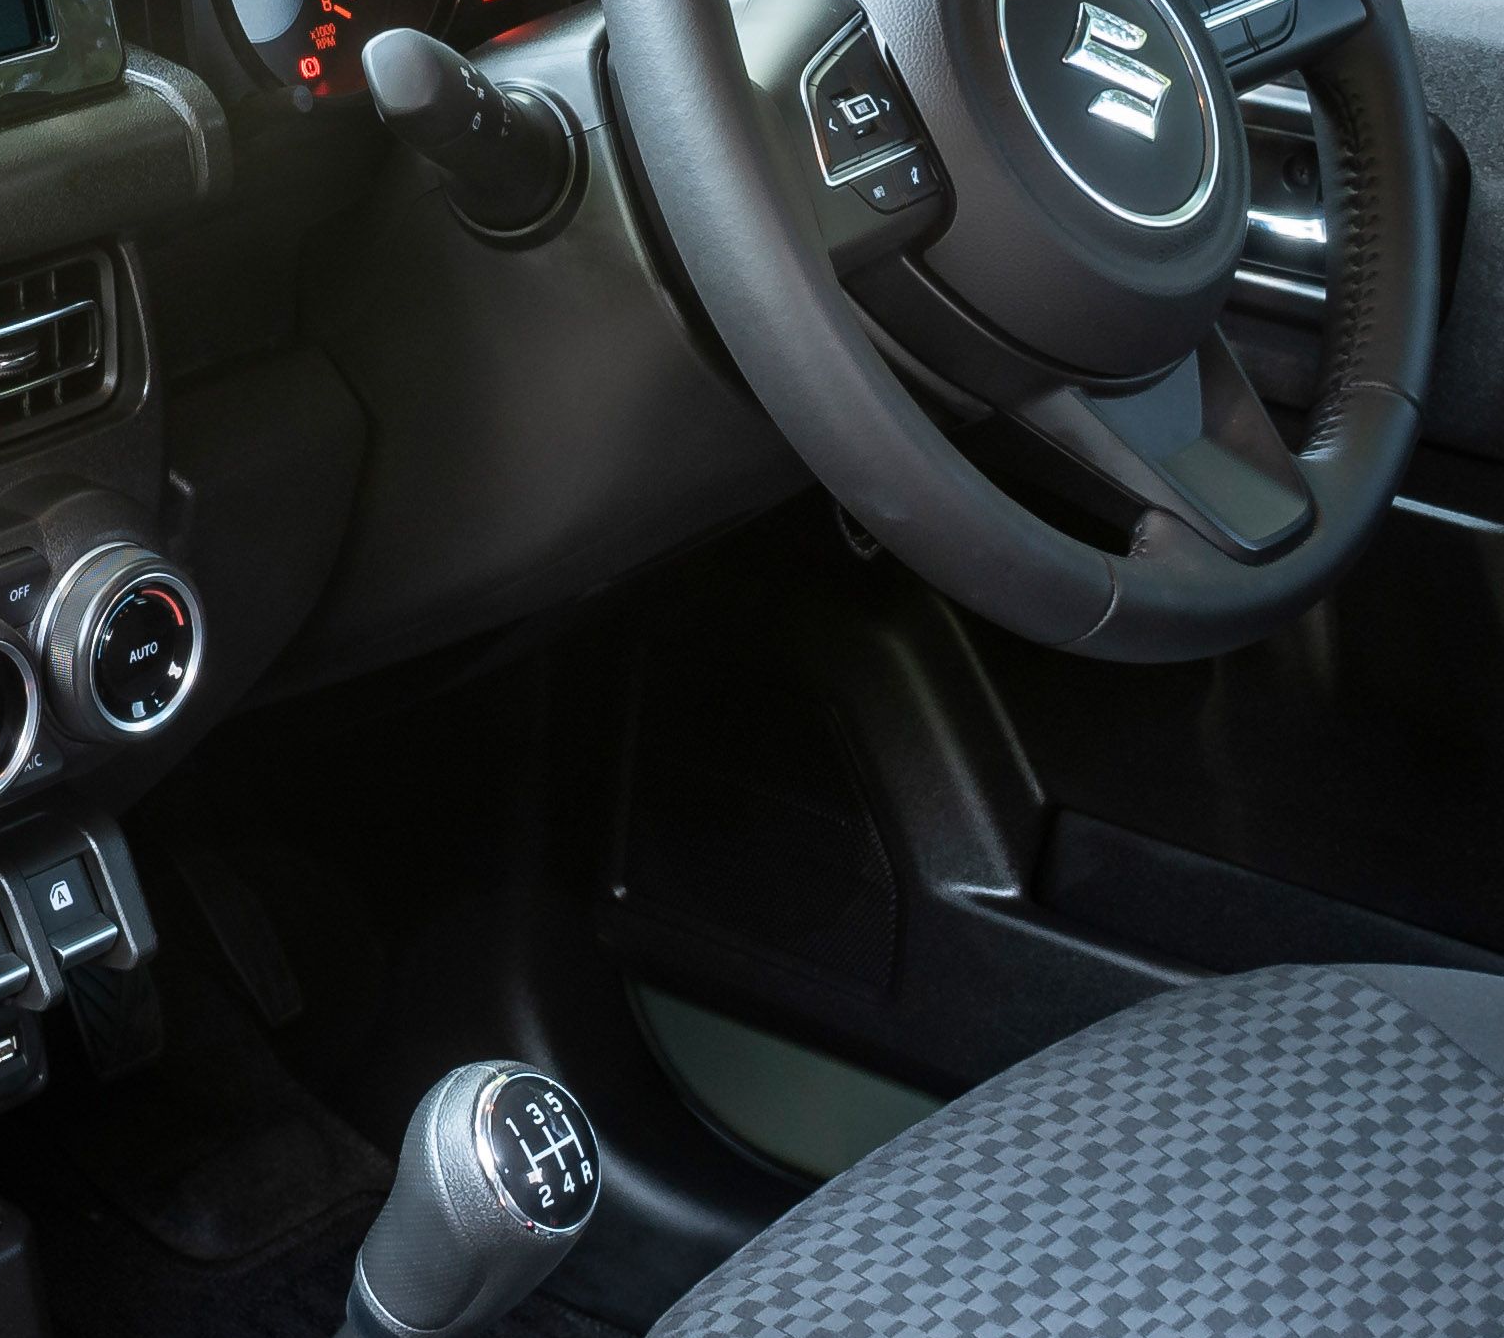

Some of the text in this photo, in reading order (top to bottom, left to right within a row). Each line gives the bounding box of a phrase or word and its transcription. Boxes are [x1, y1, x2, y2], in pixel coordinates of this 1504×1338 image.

[310, 23, 336, 40] x1000
[316, 35, 337, 50] RPM
[9, 584, 31, 602] OFF
[129, 642, 158, 664] AUTO
[505, 1091, 563, 1137] 1 3 5
[538, 1160, 594, 1208] 2 4 R
